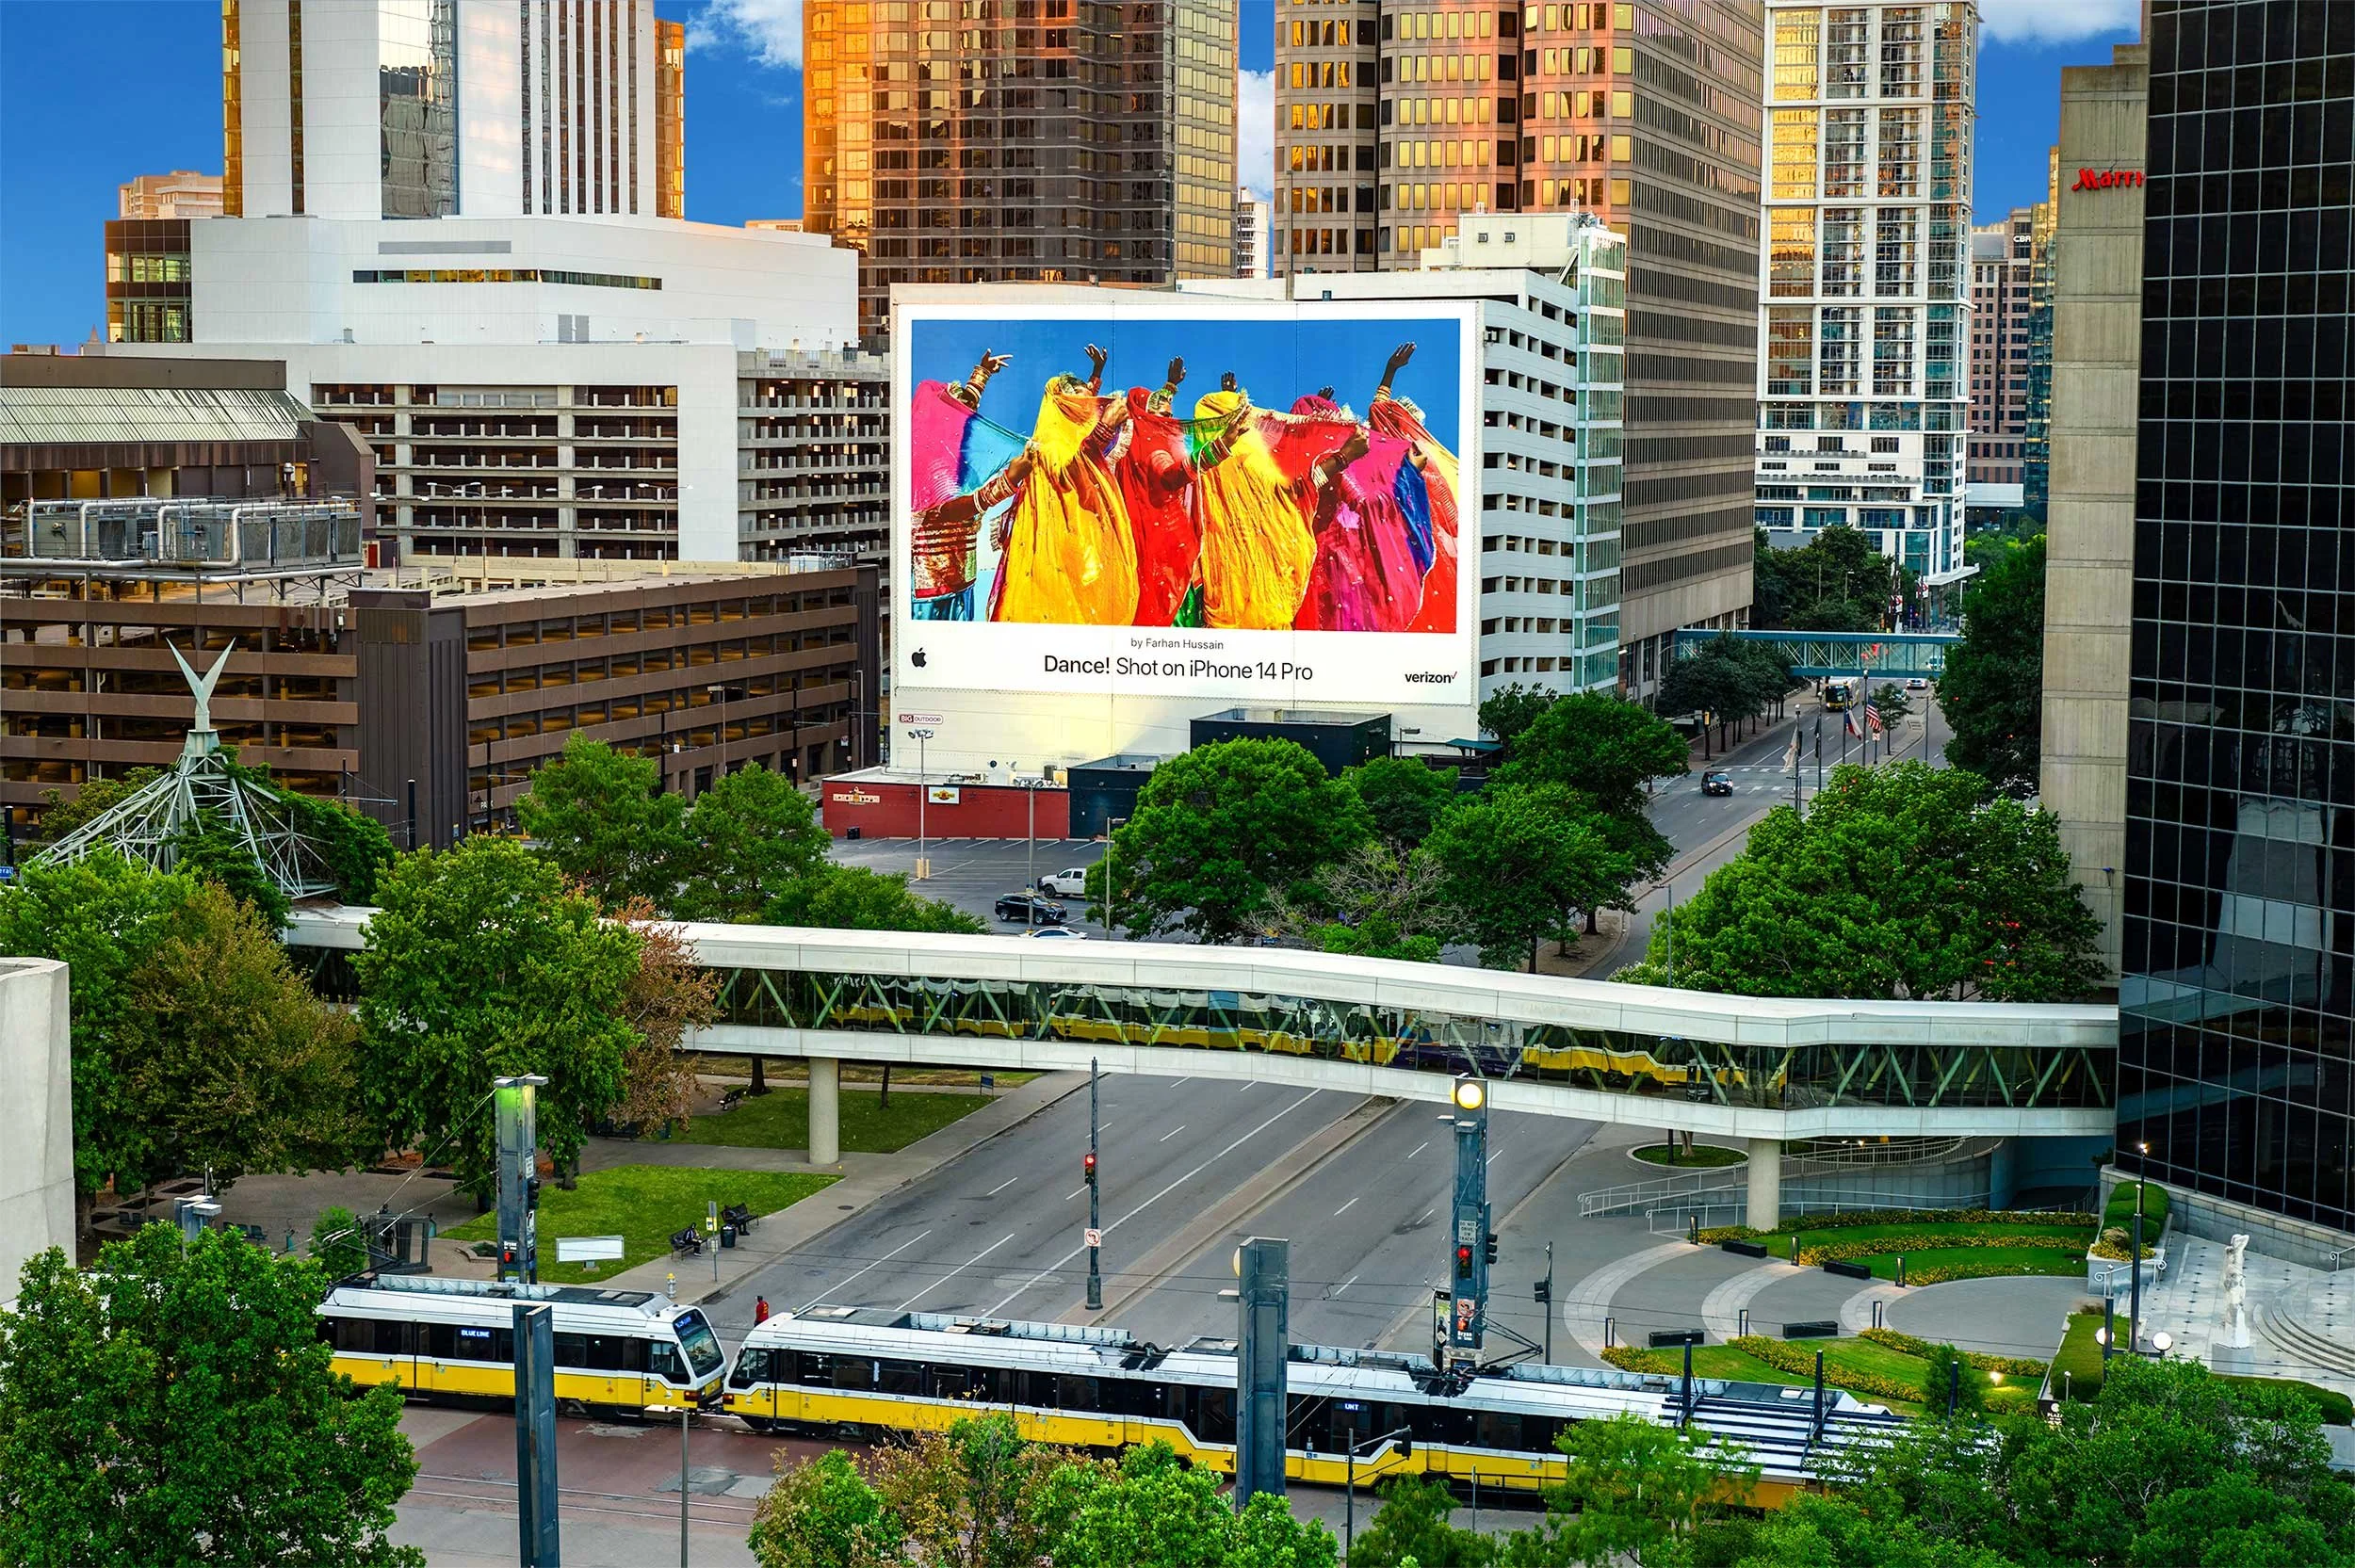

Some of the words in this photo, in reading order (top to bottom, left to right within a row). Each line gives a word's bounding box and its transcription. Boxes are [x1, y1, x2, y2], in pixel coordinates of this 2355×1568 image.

[2071, 168, 2146, 191] Marri
[1130, 638, 1143, 650] by
[1145, 638, 1180, 648] Farhan
[1183, 639, 1224, 650] Hussain
[1044, 655, 1110, 674] Dance!
[1116, 656, 1158, 675] Shot
[1162, 662, 1185, 676] on
[1190, 659, 1253, 678] iPhone
[1256, 661, 1276, 680] 14
[1281, 662, 1313, 681] Pro
[1405, 671, 1452, 684] verizon
[480, 800, 494, 810] PAK
